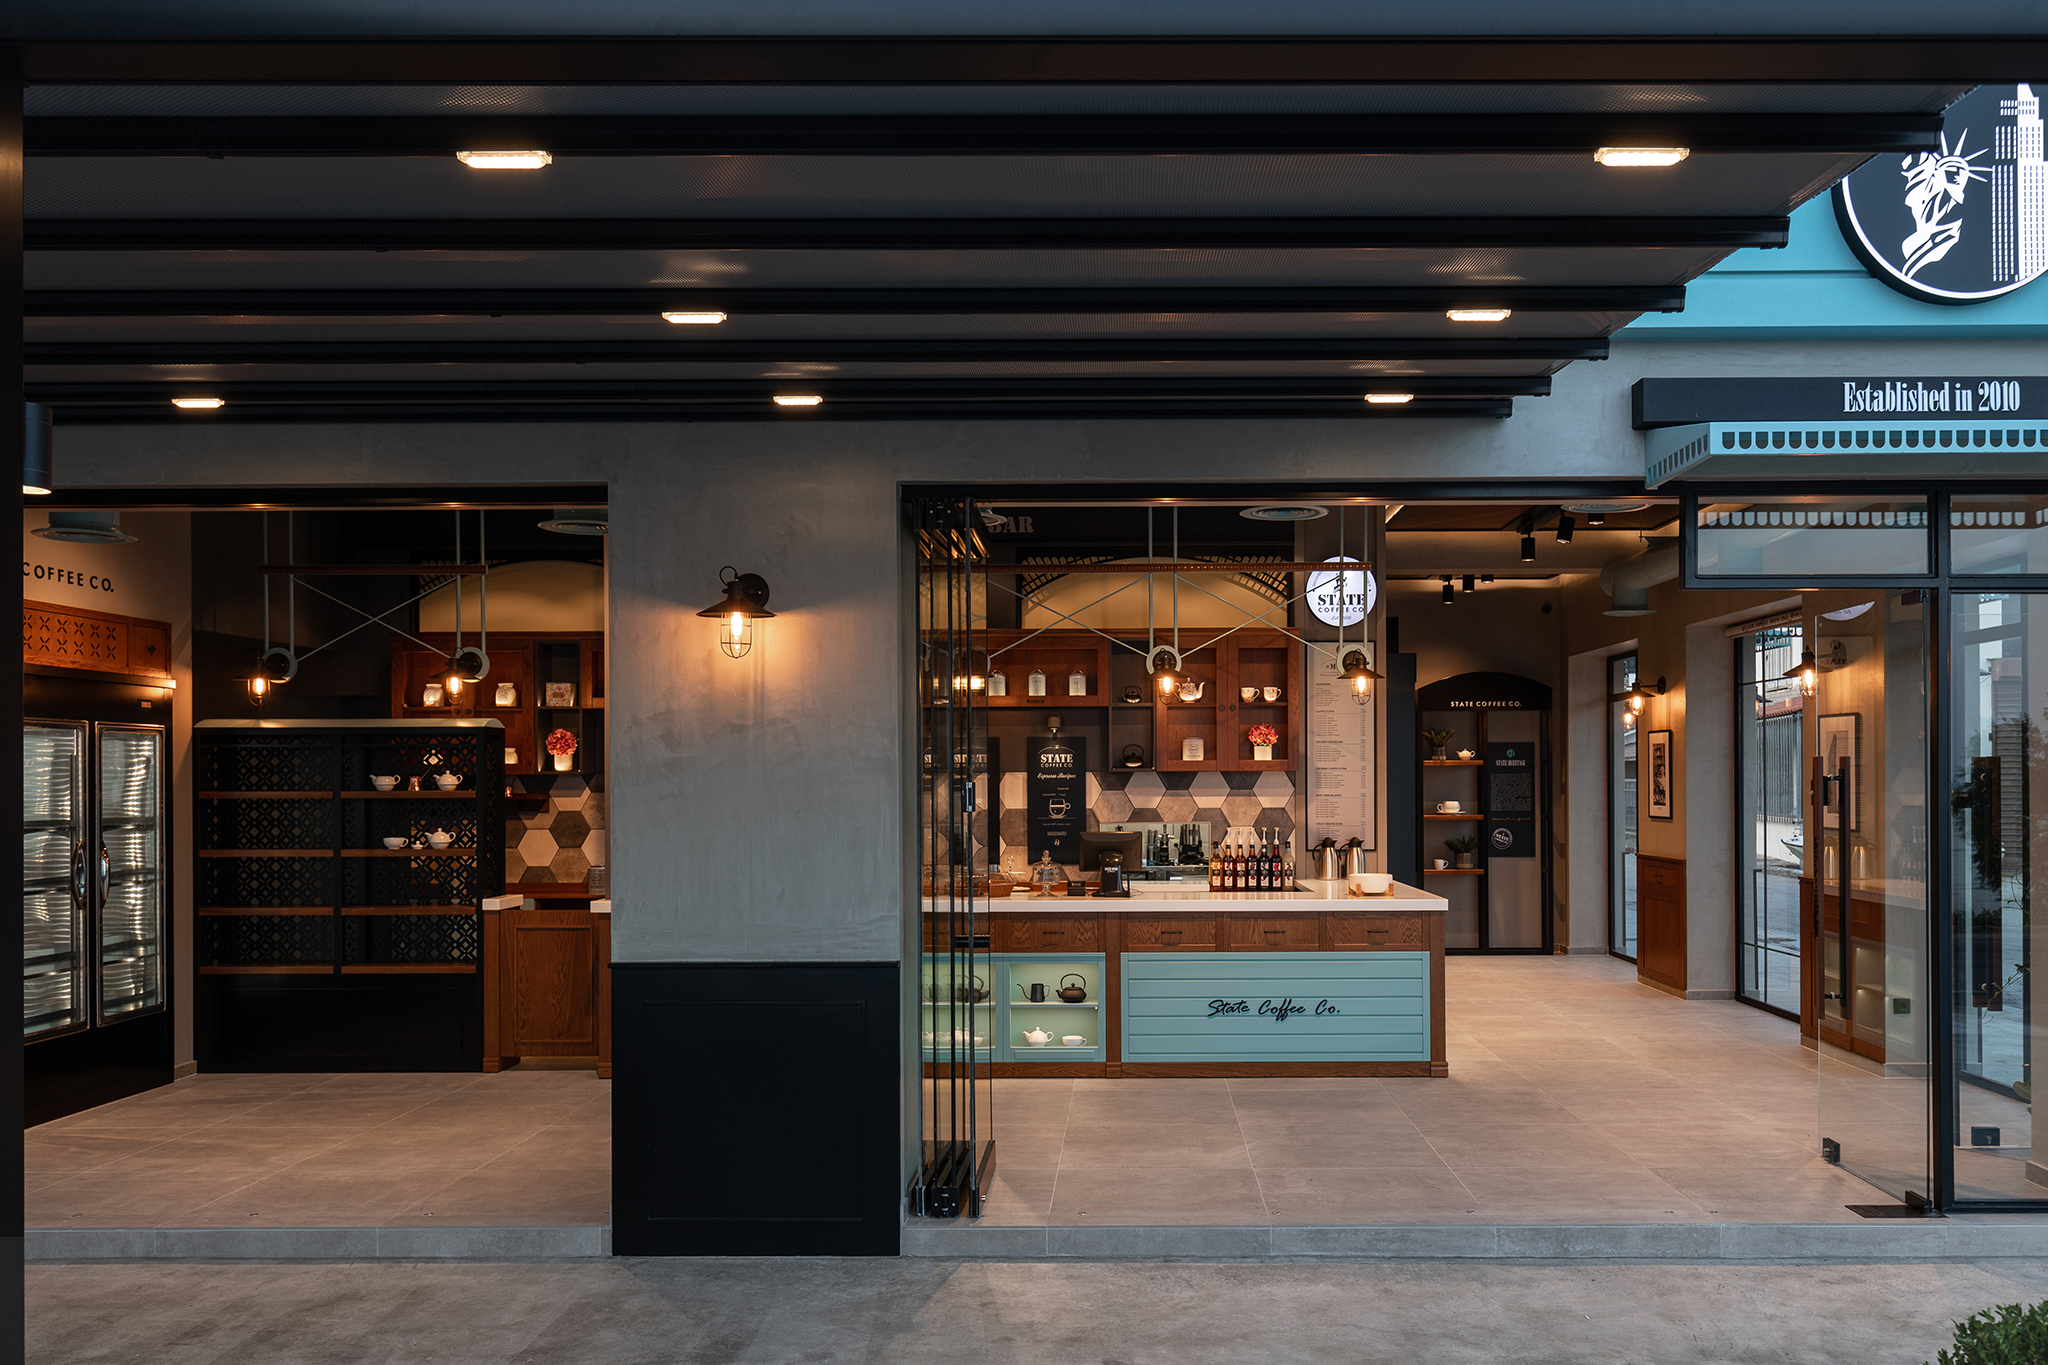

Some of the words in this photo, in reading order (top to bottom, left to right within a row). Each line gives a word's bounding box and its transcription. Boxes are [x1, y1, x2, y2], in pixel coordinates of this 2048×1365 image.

[1843, 381, 1950, 412] Established
[1954, 383, 1973, 412] in
[1978, 381, 2021, 412] 2010
[23, 562, 84, 587] COFFEE
[89, 576, 114, 593] CO.
[1317, 593, 1365, 606] STATE
[1040, 753, 1073, 763] STATE
[1207, 999, 1250, 1017] State
[1258, 998, 1306, 1022] Coffee
[1315, 999, 1341, 1016] Co.
